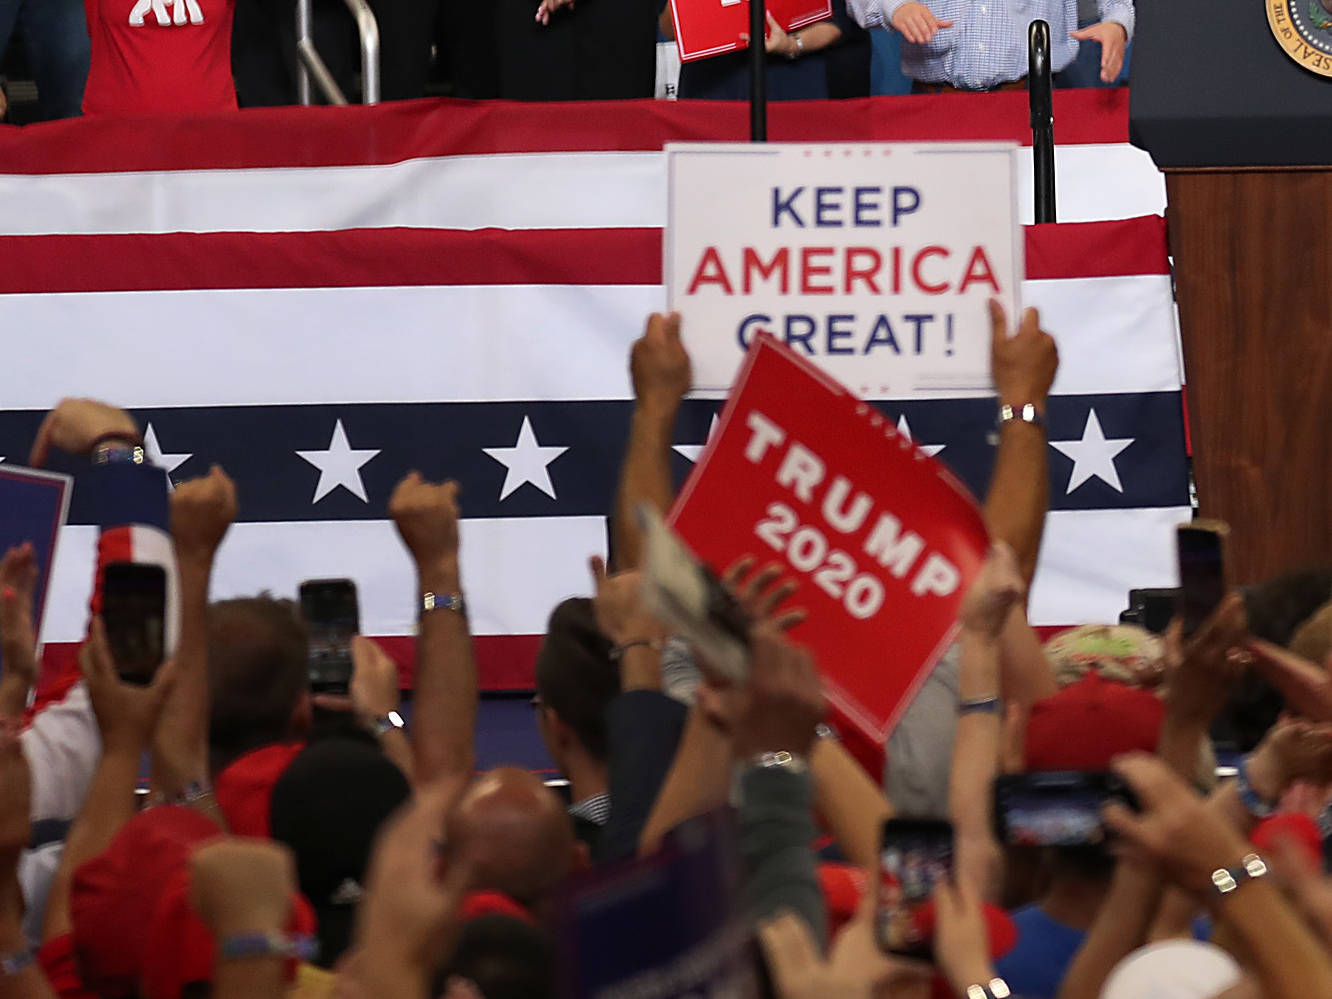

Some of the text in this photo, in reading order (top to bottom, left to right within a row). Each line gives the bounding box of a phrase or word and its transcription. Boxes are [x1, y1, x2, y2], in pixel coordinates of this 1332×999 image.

[1274, 3, 1288, 24] THE
[1279, 27, 1293, 40] OF
[1295, 38, 1332, 70] SEAL
[771, 186, 922, 229] KEEP
[685, 245, 1002, 297] AMERICA
[737, 313, 955, 357] GREAT!
[744, 410, 963, 599] TRUMP
[754, 504, 886, 621] 2020
